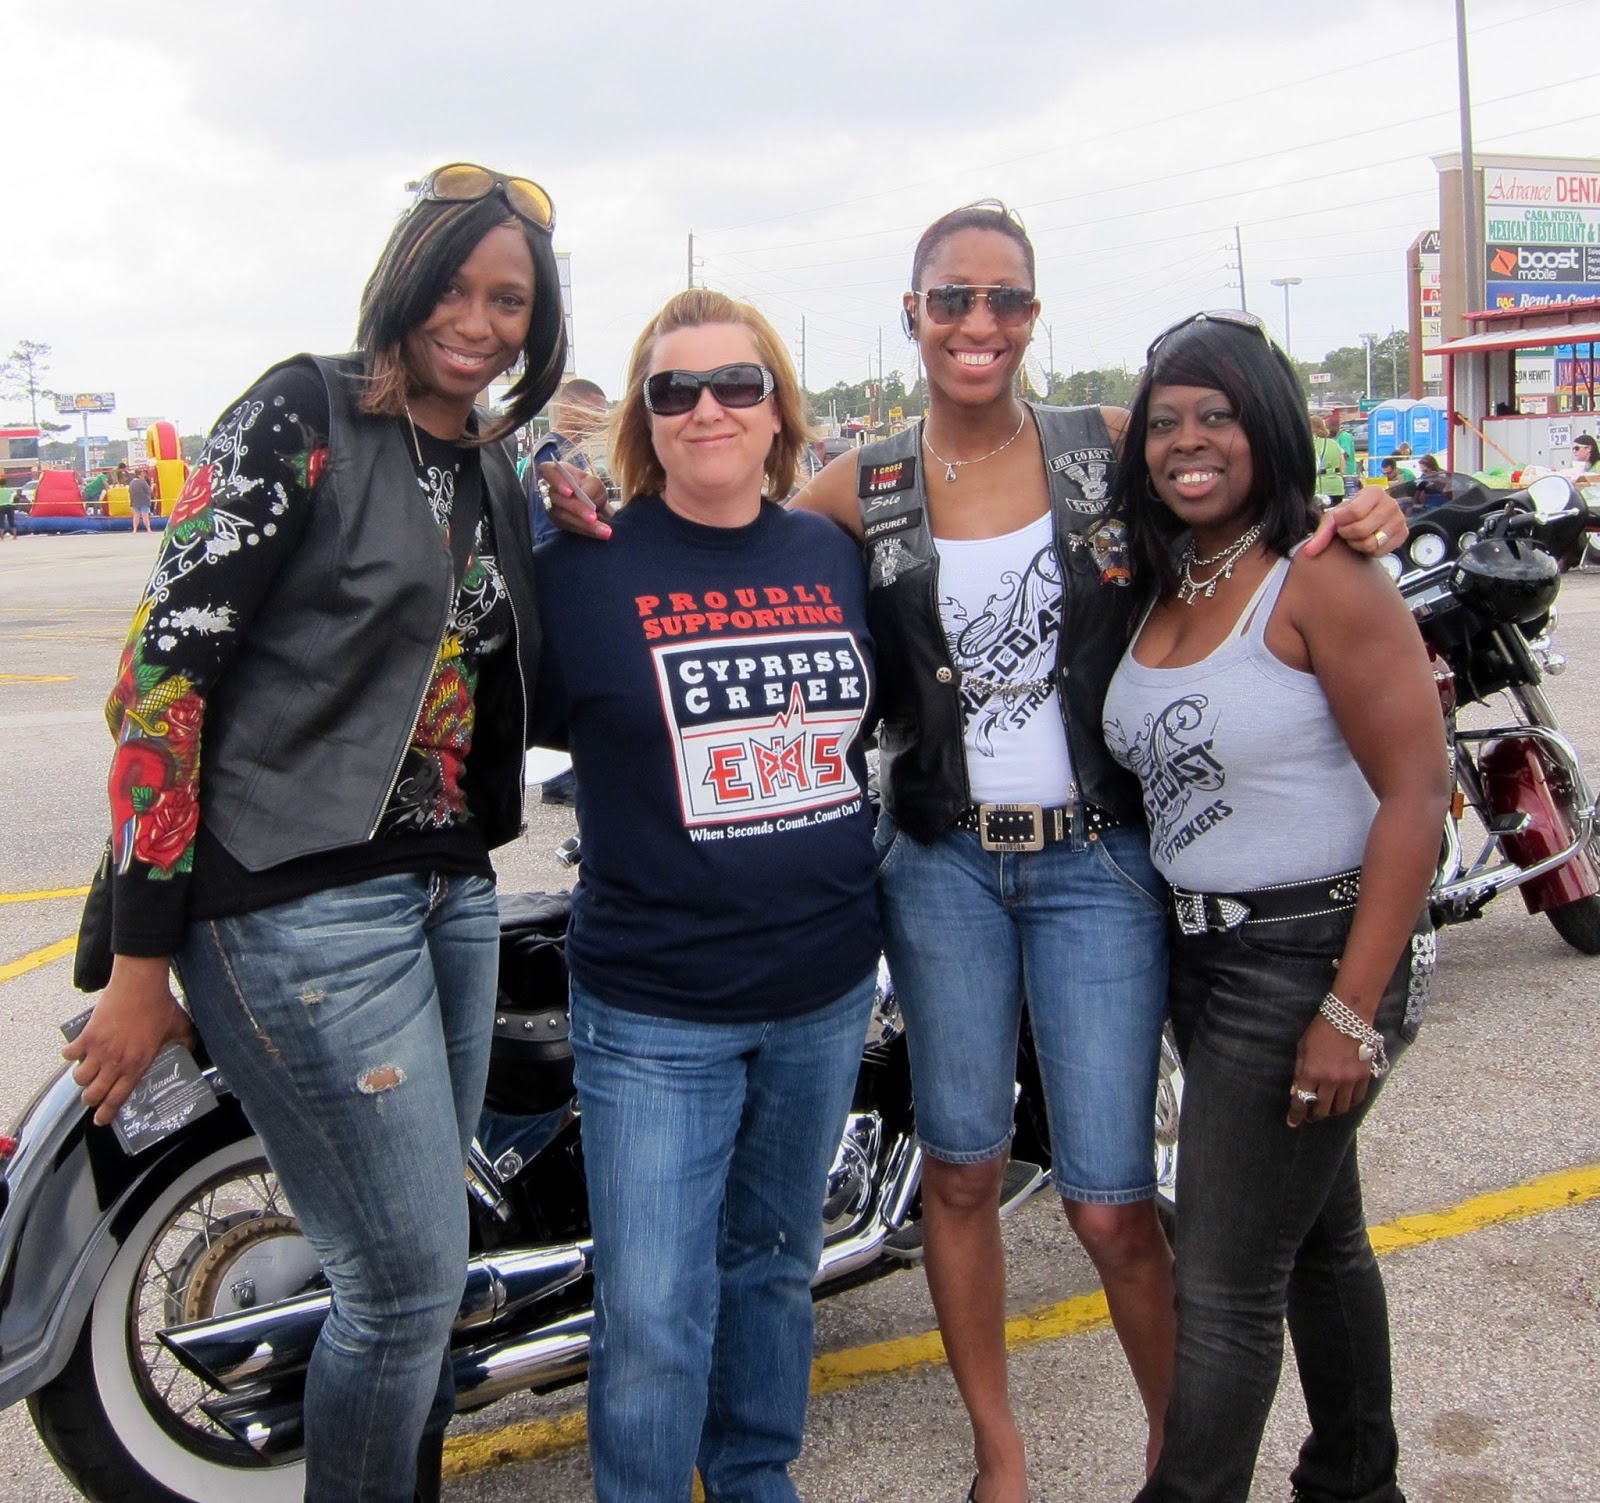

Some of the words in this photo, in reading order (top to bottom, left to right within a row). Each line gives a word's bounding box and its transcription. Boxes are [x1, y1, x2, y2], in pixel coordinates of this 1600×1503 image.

[1487, 173, 1552, 201] Advance
[1524, 210, 1549, 221] CASA
[1551, 211, 1583, 222] NUEVA
[1488, 220, 1527, 241] MEXICAN
[1531, 222, 1586, 242] RESTAURANT
[1588, 223, 1595, 242] &
[1518, 247, 1579, 269] boost
[1518, 270, 1557, 280] mobile
[1497, 297, 1515, 308] RAC
[1529, 370, 1550, 381] HEWITT
[880, 462, 903, 474] CROSS
[1053, 454, 1072, 469] 3RD
[1075, 449, 1110, 461] COAST
[878, 480, 897, 490] EVER
[867, 495, 900, 513] Solo
[635, 585, 833, 617] PROUDLY
[643, 606, 843, 639] SUPPORTING
[679, 650, 855, 684] CYPRESS
[685, 677, 860, 714] CREEK
[702, 731, 847, 805] EMS
[689, 827, 724, 842] When
[727, 822, 774, 838] Seconds
[842, 805, 854, 816] On
[1164, 799, 1234, 864] STROKERS
[140, 1063, 180, 1104] Annual
